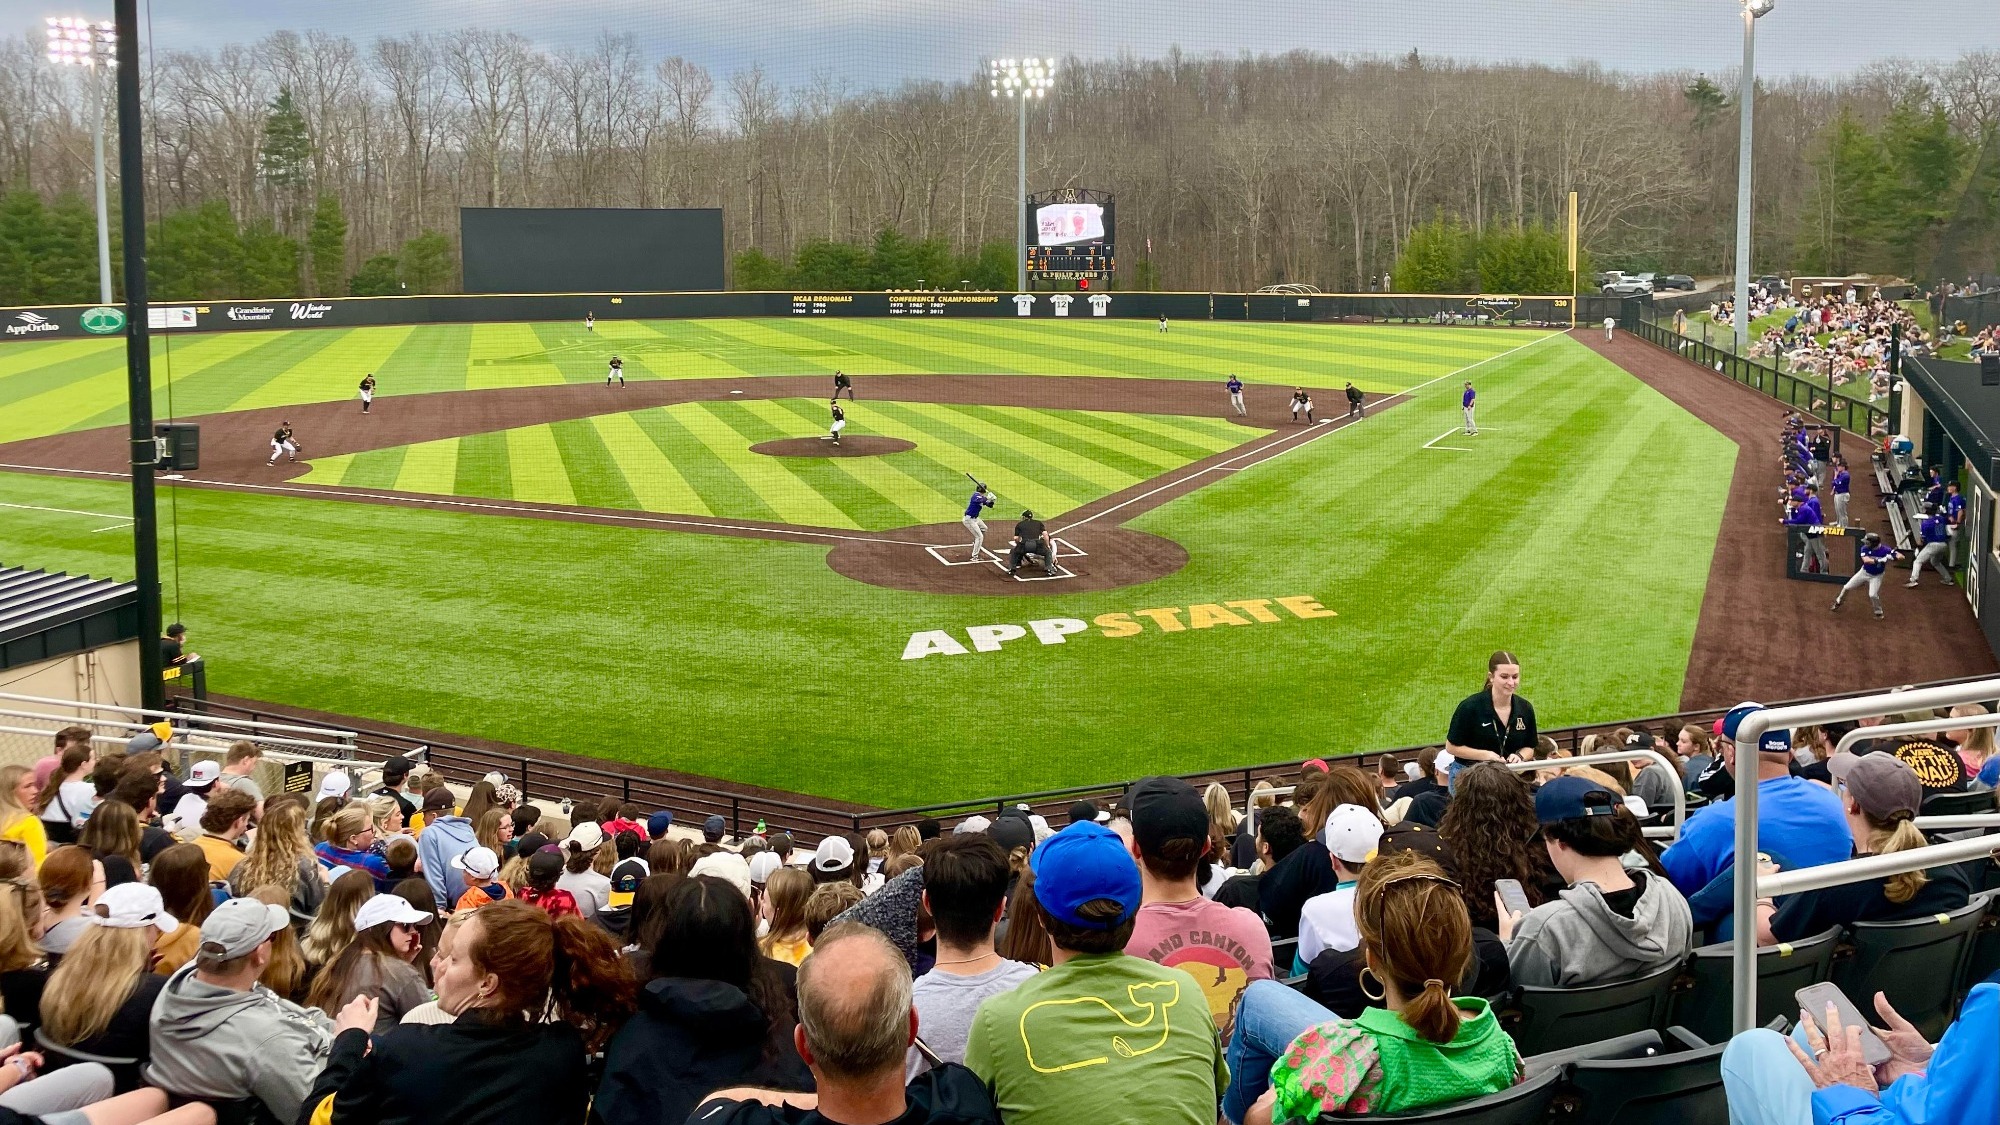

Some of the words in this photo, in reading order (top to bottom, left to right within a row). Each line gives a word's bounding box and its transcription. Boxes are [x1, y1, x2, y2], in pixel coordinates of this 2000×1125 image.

[6, 322, 59, 334] AppOrtho
[1926, 754, 1950, 767] THE
[1148, 934, 1184, 964] AND
[1190, 931, 1255, 970] CANYON
